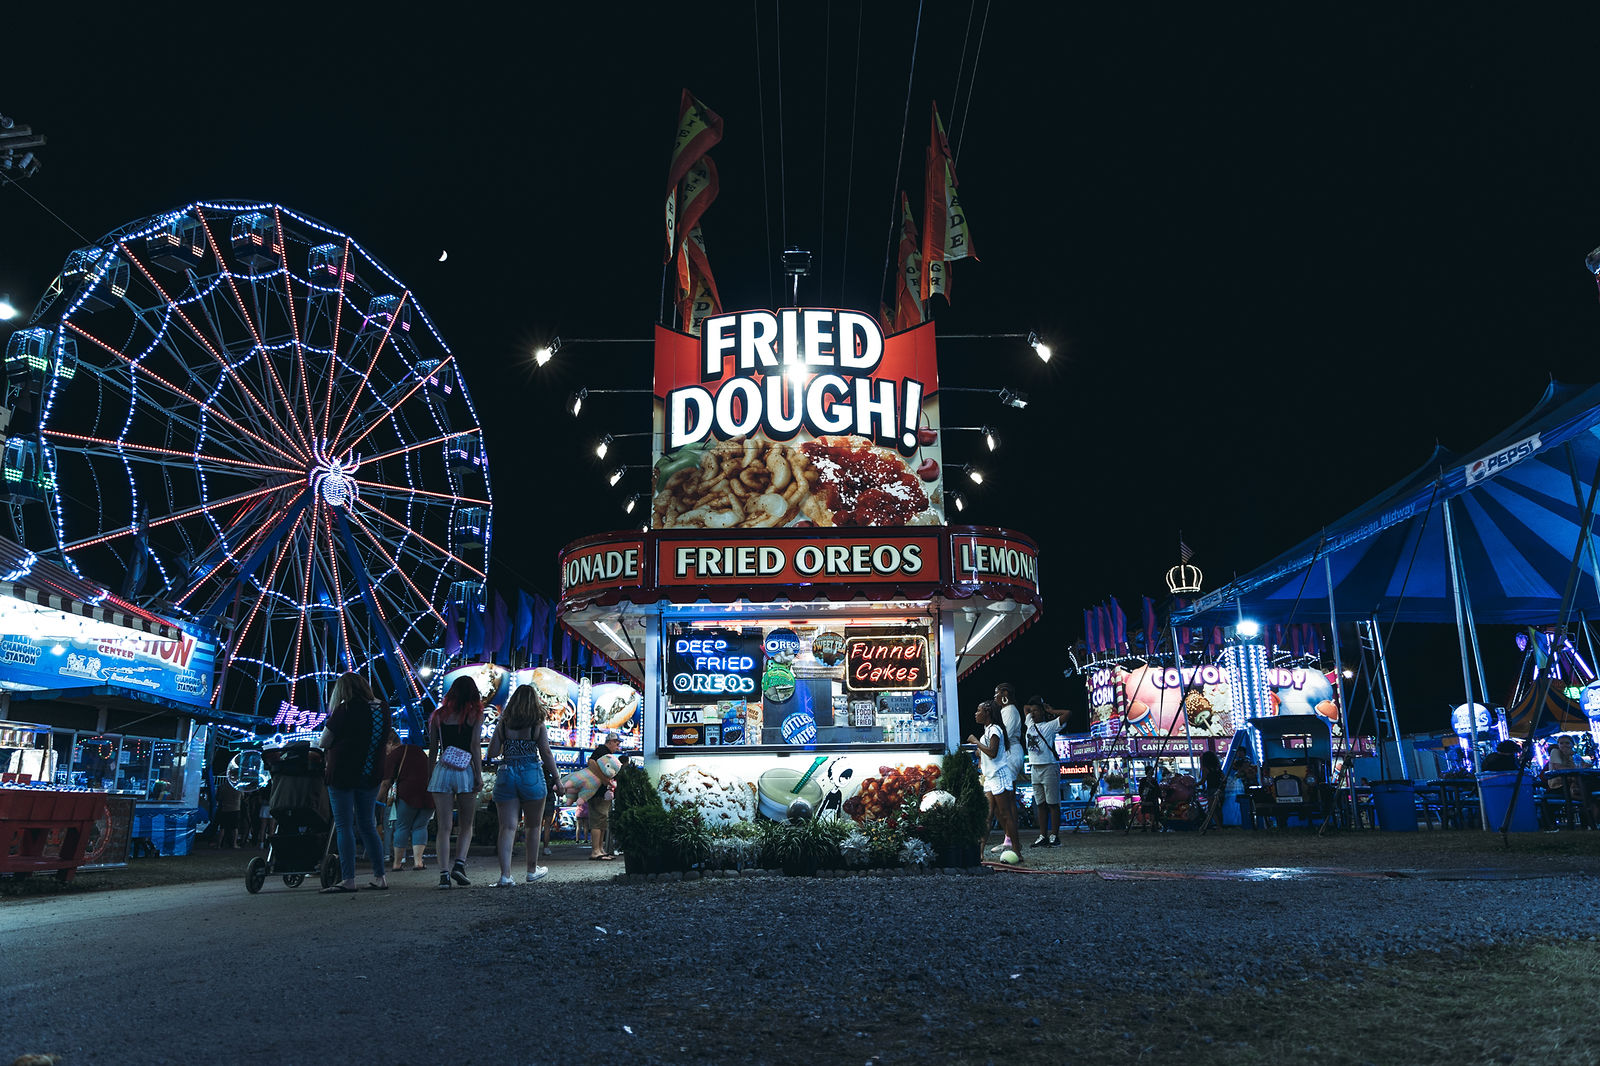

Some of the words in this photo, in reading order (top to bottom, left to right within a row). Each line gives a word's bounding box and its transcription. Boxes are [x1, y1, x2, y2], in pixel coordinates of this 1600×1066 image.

[706, 310, 883, 375] FRIED
[670, 373, 922, 449] DOUGH!
[1487, 440, 1535, 472] PEPSI
[1340, 520, 1379, 545] American
[1380, 502, 1416, 526] Midway
[566, 549, 639, 588] ONADE
[675, 546, 787, 576] FRIED
[795, 544, 923, 575] OREOS
[2, 641, 41, 656] CHANGING
[98, 644, 135, 660] CENTER
[675, 639, 727, 654] DEEP
[850, 642, 923, 660] Funnel
[5, 651, 37, 665] STATION
[695, 656, 754, 671] FRIED
[855, 662, 920, 682] Cakes
[1093, 669, 1110, 688] POP
[673, 673, 755, 692] OREOS
[1092, 686, 1114, 706] CORN
[671, 711, 698, 723] VISA
[782, 714, 813, 739] BOTTLED
[1137, 718, 1155, 735] ICEE
[789, 725, 817, 745] WATER
[1172, 743, 1204, 751] APPLES
[556, 753, 572, 762] DOGS
[1065, 809, 1082, 821] TIC
